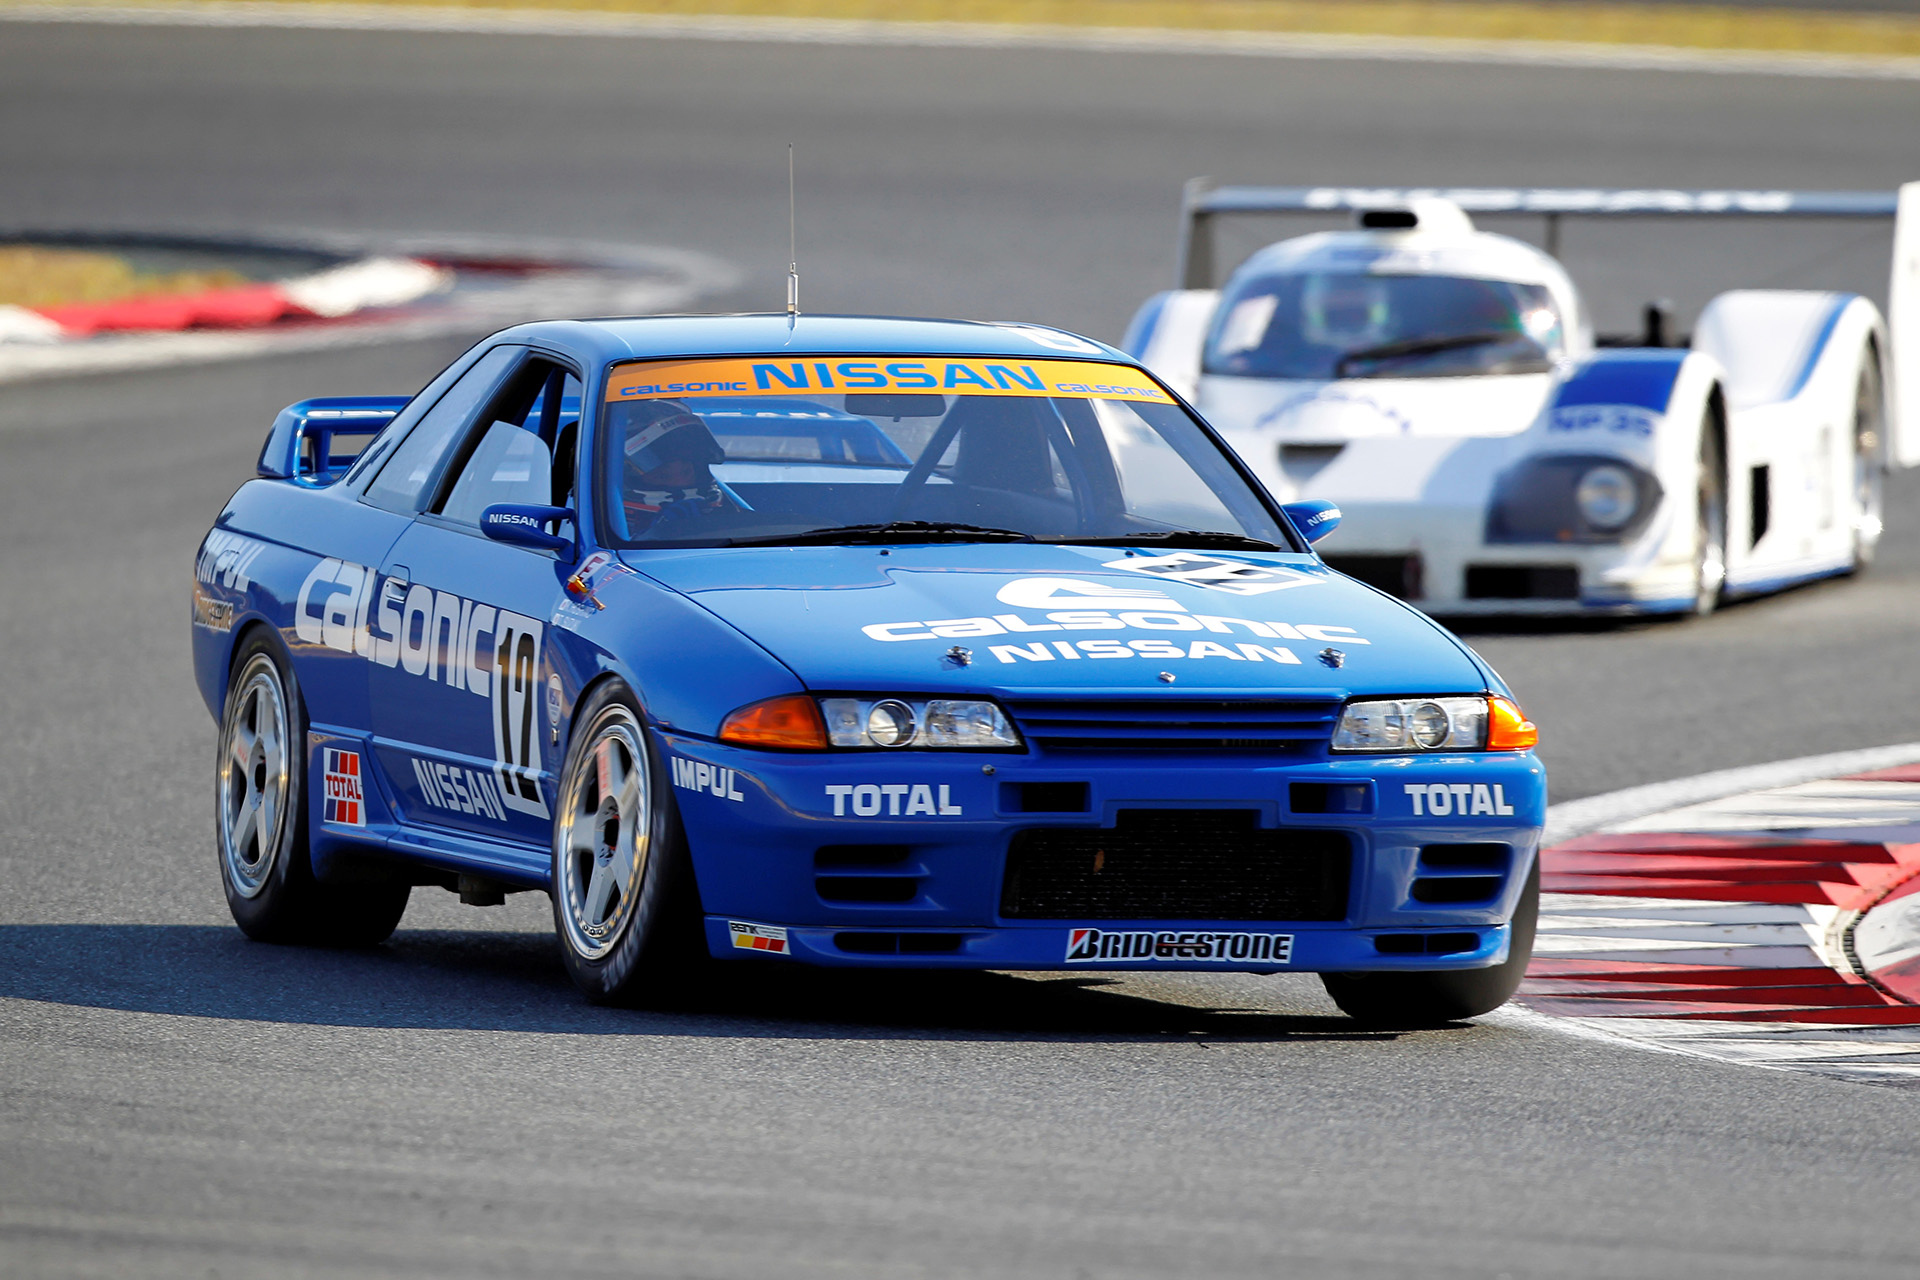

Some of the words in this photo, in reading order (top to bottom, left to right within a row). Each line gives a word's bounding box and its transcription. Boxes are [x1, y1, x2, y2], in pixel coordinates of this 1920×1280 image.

[752, 362, 1048, 392] NISSAN
[489, 513, 539, 529] NISSAN
[986, 638, 1303, 666] NISSAN
[497, 626, 541, 804] 12
[325, 774, 362, 801] TOTAL
[411, 757, 508, 822] NISSAN
[670, 756, 745, 803] IMPUL
[825, 784, 963, 816] TOTAL
[1403, 783, 1514, 816] TOTAL
[1065, 929, 1294, 963] BRIDGESTONE
